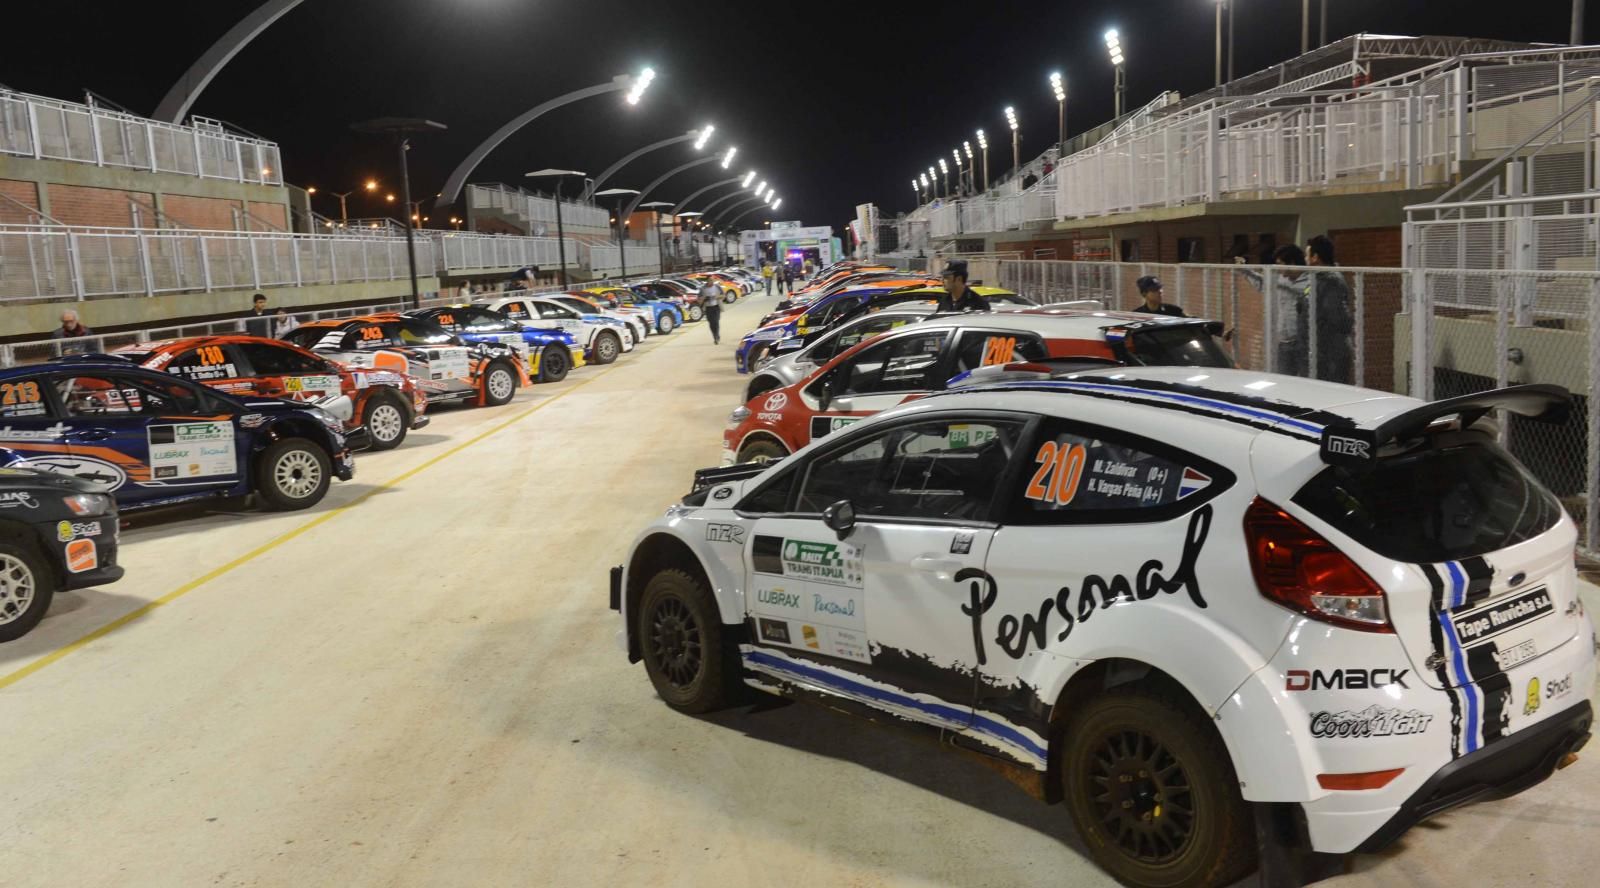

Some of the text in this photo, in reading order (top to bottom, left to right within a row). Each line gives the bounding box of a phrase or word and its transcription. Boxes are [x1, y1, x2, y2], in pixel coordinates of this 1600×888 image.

[360, 326, 384, 341] 243
[1, 381, 41, 404] 213
[757, 412, 783, 422] TOYOTA
[951, 431, 967, 442] BR
[154, 450, 190, 460] LUBRAX
[1024, 441, 1087, 506] 210
[1097, 479, 1123, 497] Vargas
[1123, 483, 1143, 499] Peña
[787, 562, 812, 575] TRANS
[954, 502, 1214, 665] Personal
[758, 589, 855, 617] LUBRAX Personal
[1456, 616, 1490, 637] Tape
[1489, 600, 1537, 627] Ruvicha
[1286, 669, 1411, 691] DMACK
[1310, 711, 1371, 739] Coors
